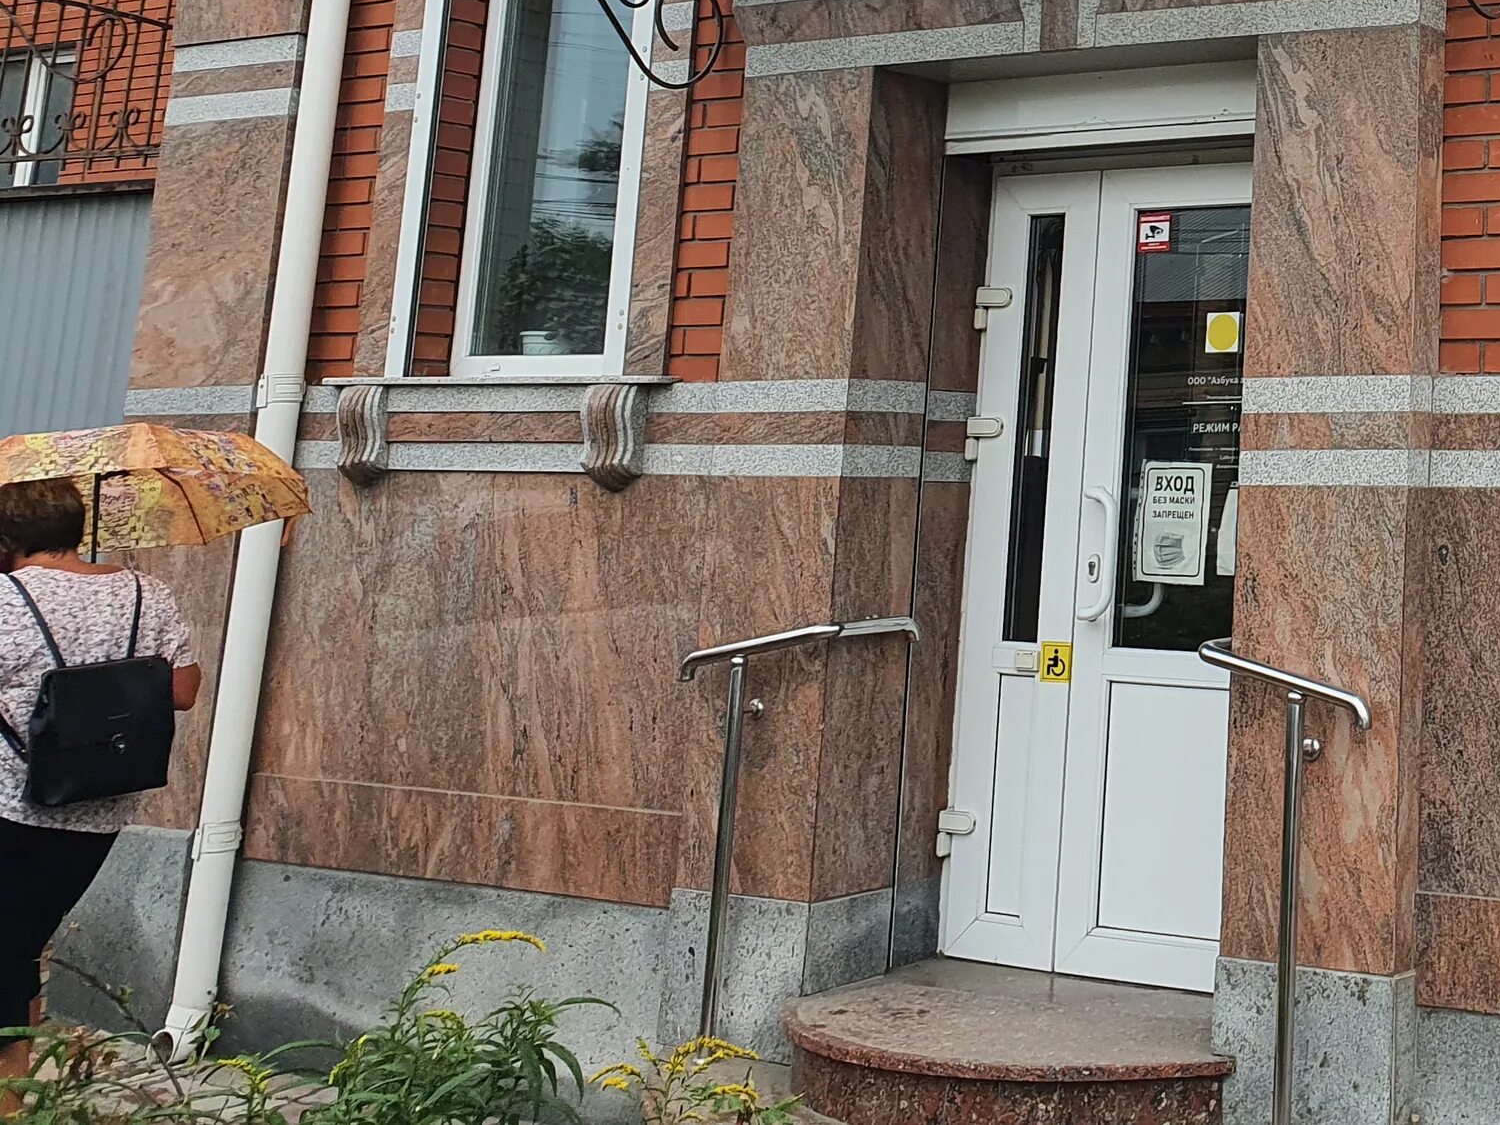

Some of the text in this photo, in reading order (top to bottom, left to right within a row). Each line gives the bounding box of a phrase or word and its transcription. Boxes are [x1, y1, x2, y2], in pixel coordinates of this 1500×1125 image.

[1187, 376, 1207, 385] ООО
[1192, 422, 1230, 433] РЕЖИМ
[1154, 475, 1195, 495] ВХОД
[1152, 496, 1195, 504] БЕЗ МАСКИ
[1152, 510, 1194, 520] ЗАПРЕЩЕН
